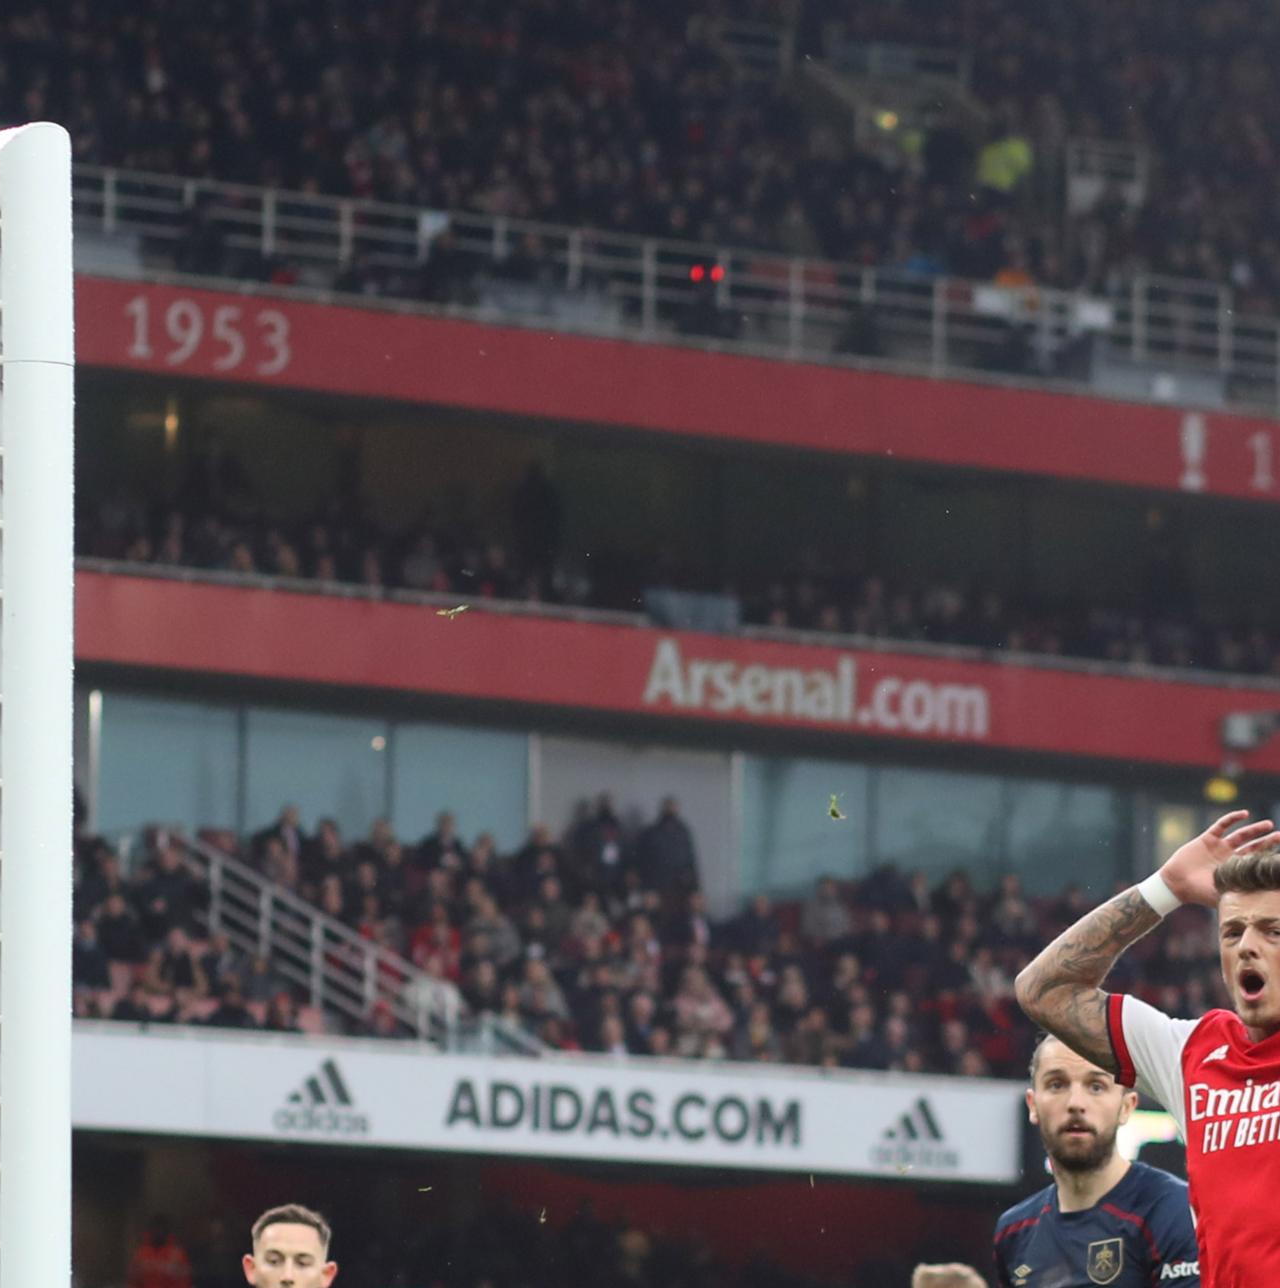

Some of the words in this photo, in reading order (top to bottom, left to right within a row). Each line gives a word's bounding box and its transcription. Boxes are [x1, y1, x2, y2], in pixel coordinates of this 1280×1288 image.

[124, 297, 293, 376] 1953
[644, 639, 990, 738] Arsenal.com
[446, 1079, 802, 1149] ADIDAS.COM
[1202, 1119, 1231, 1154] FLY
